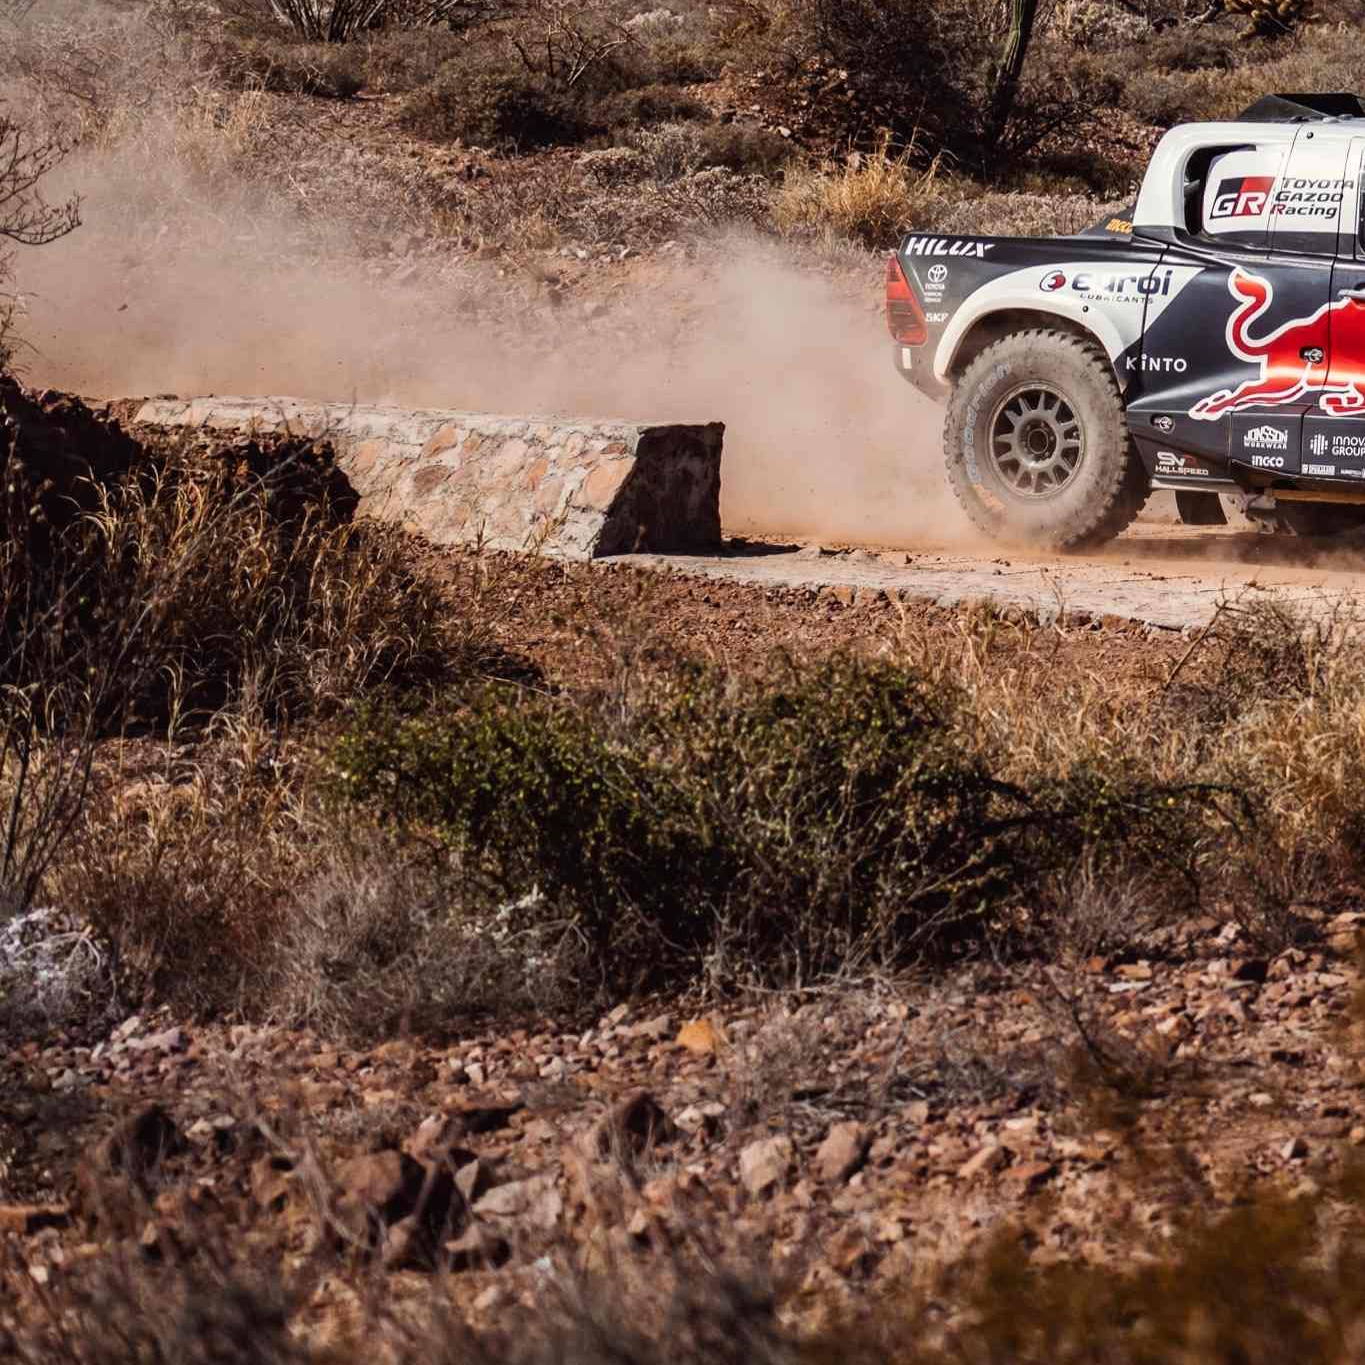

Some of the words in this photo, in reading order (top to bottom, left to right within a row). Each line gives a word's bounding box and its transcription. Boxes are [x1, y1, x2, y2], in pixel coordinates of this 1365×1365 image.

[1282, 177, 1354, 190] TOYOTA
[1275, 191, 1343, 203] GAZOO
[1211, 192, 1266, 219] GR
[1270, 204, 1338, 220] Racing
[905, 237, 995, 258] HILUX
[1243, 425, 1288, 443] JONSSON
[1155, 465, 1209, 476] HALLSPEED
